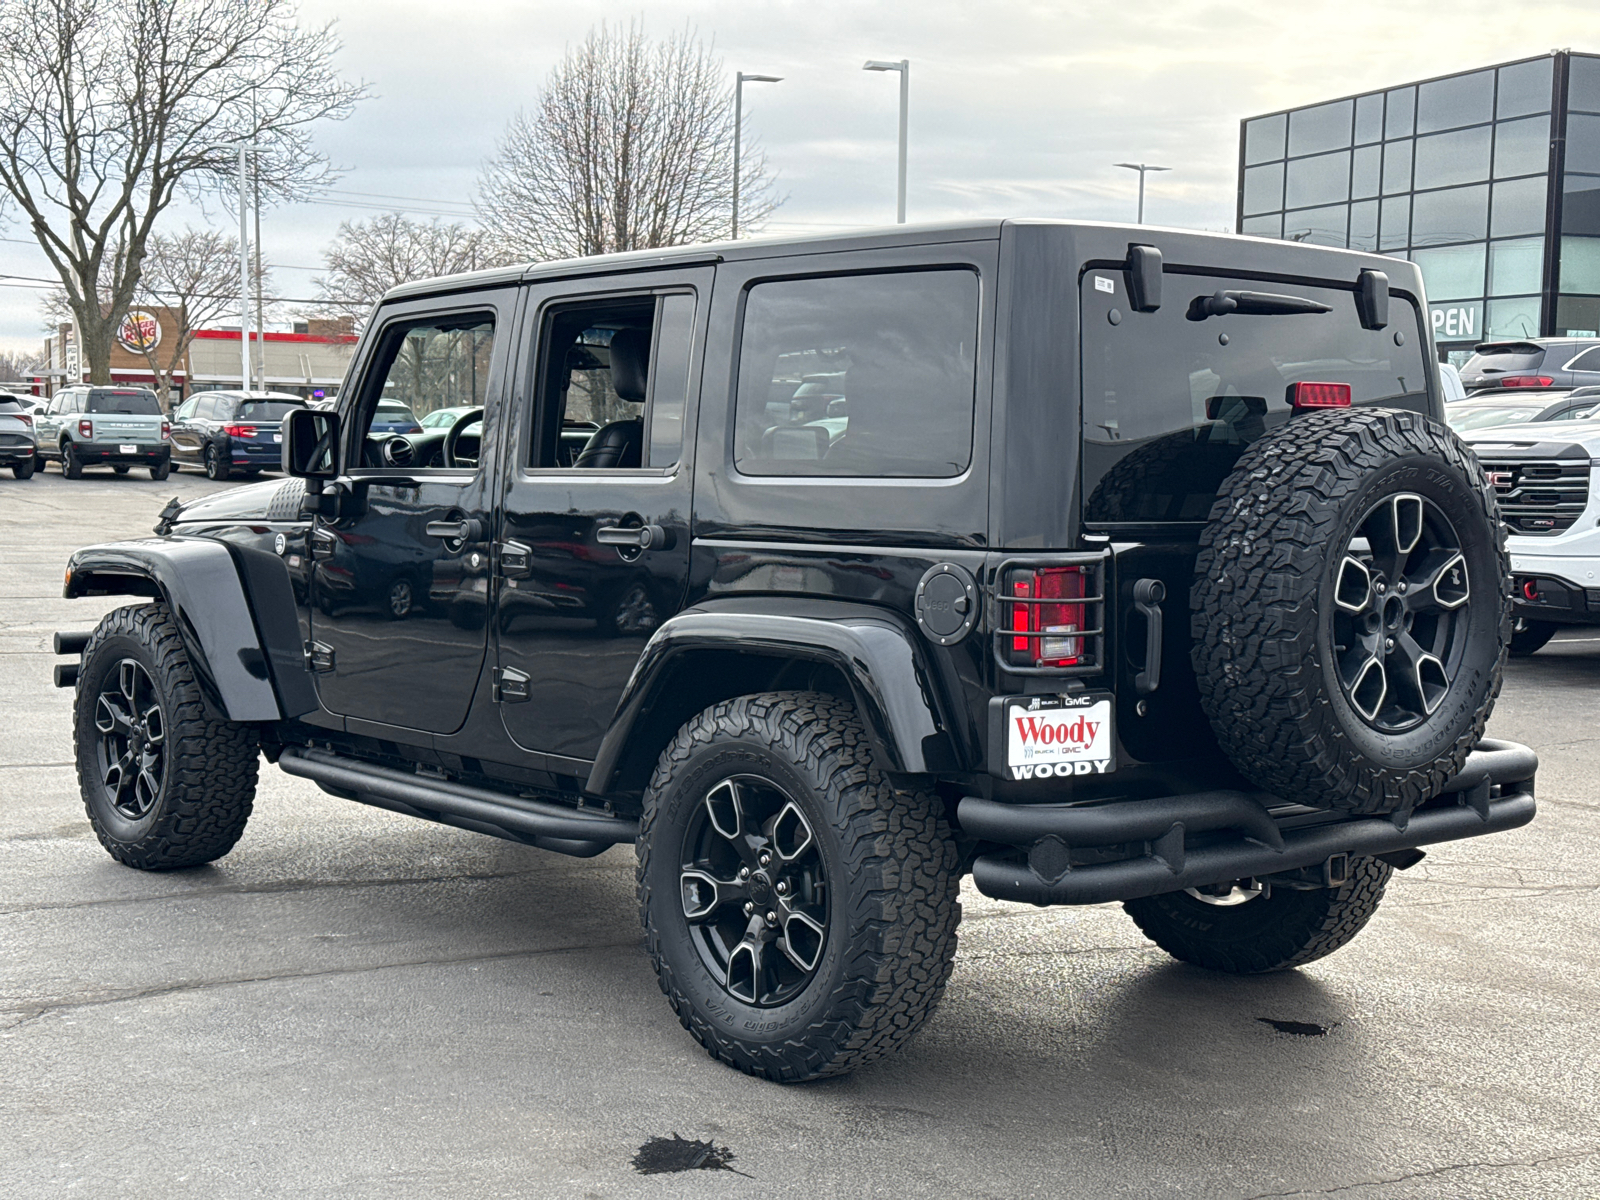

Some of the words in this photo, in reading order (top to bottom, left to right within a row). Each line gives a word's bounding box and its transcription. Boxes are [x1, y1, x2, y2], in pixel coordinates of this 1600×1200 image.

[124, 320, 154, 333] BGER
[1432, 308, 1474, 336] PEN
[67, 363, 77, 377] 45
[925, 600, 949, 612] Jeep
[1065, 697, 1091, 706] GMC
[1015, 715, 1101, 749] Woody
[1011, 759, 1111, 780] WOODY
